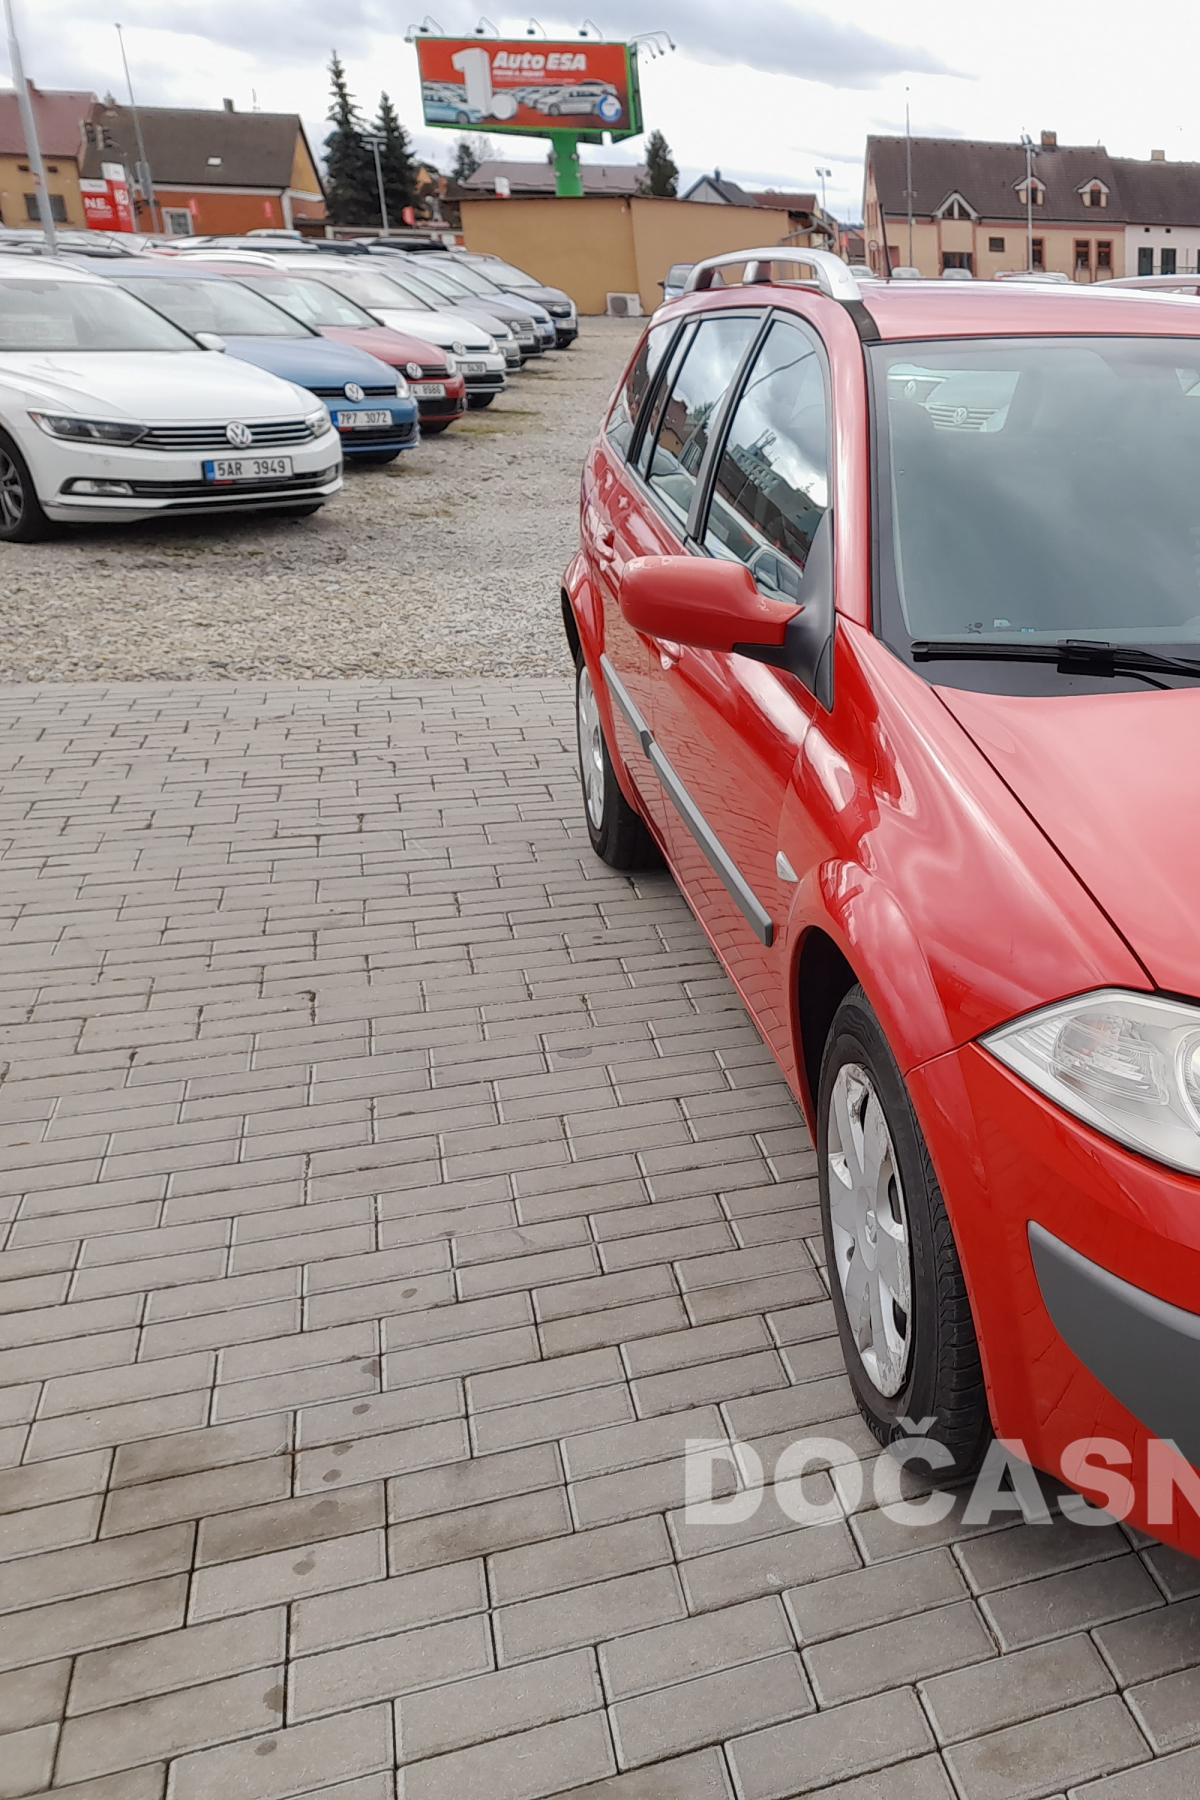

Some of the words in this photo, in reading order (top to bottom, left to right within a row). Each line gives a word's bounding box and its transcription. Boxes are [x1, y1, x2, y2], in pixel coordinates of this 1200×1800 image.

[492, 50, 546, 71] Auto
[546, 52, 588, 72] ESA
[365, 411, 388, 423] 3072
[217, 462, 242, 477] 5AR
[254, 459, 285, 475] 3949
